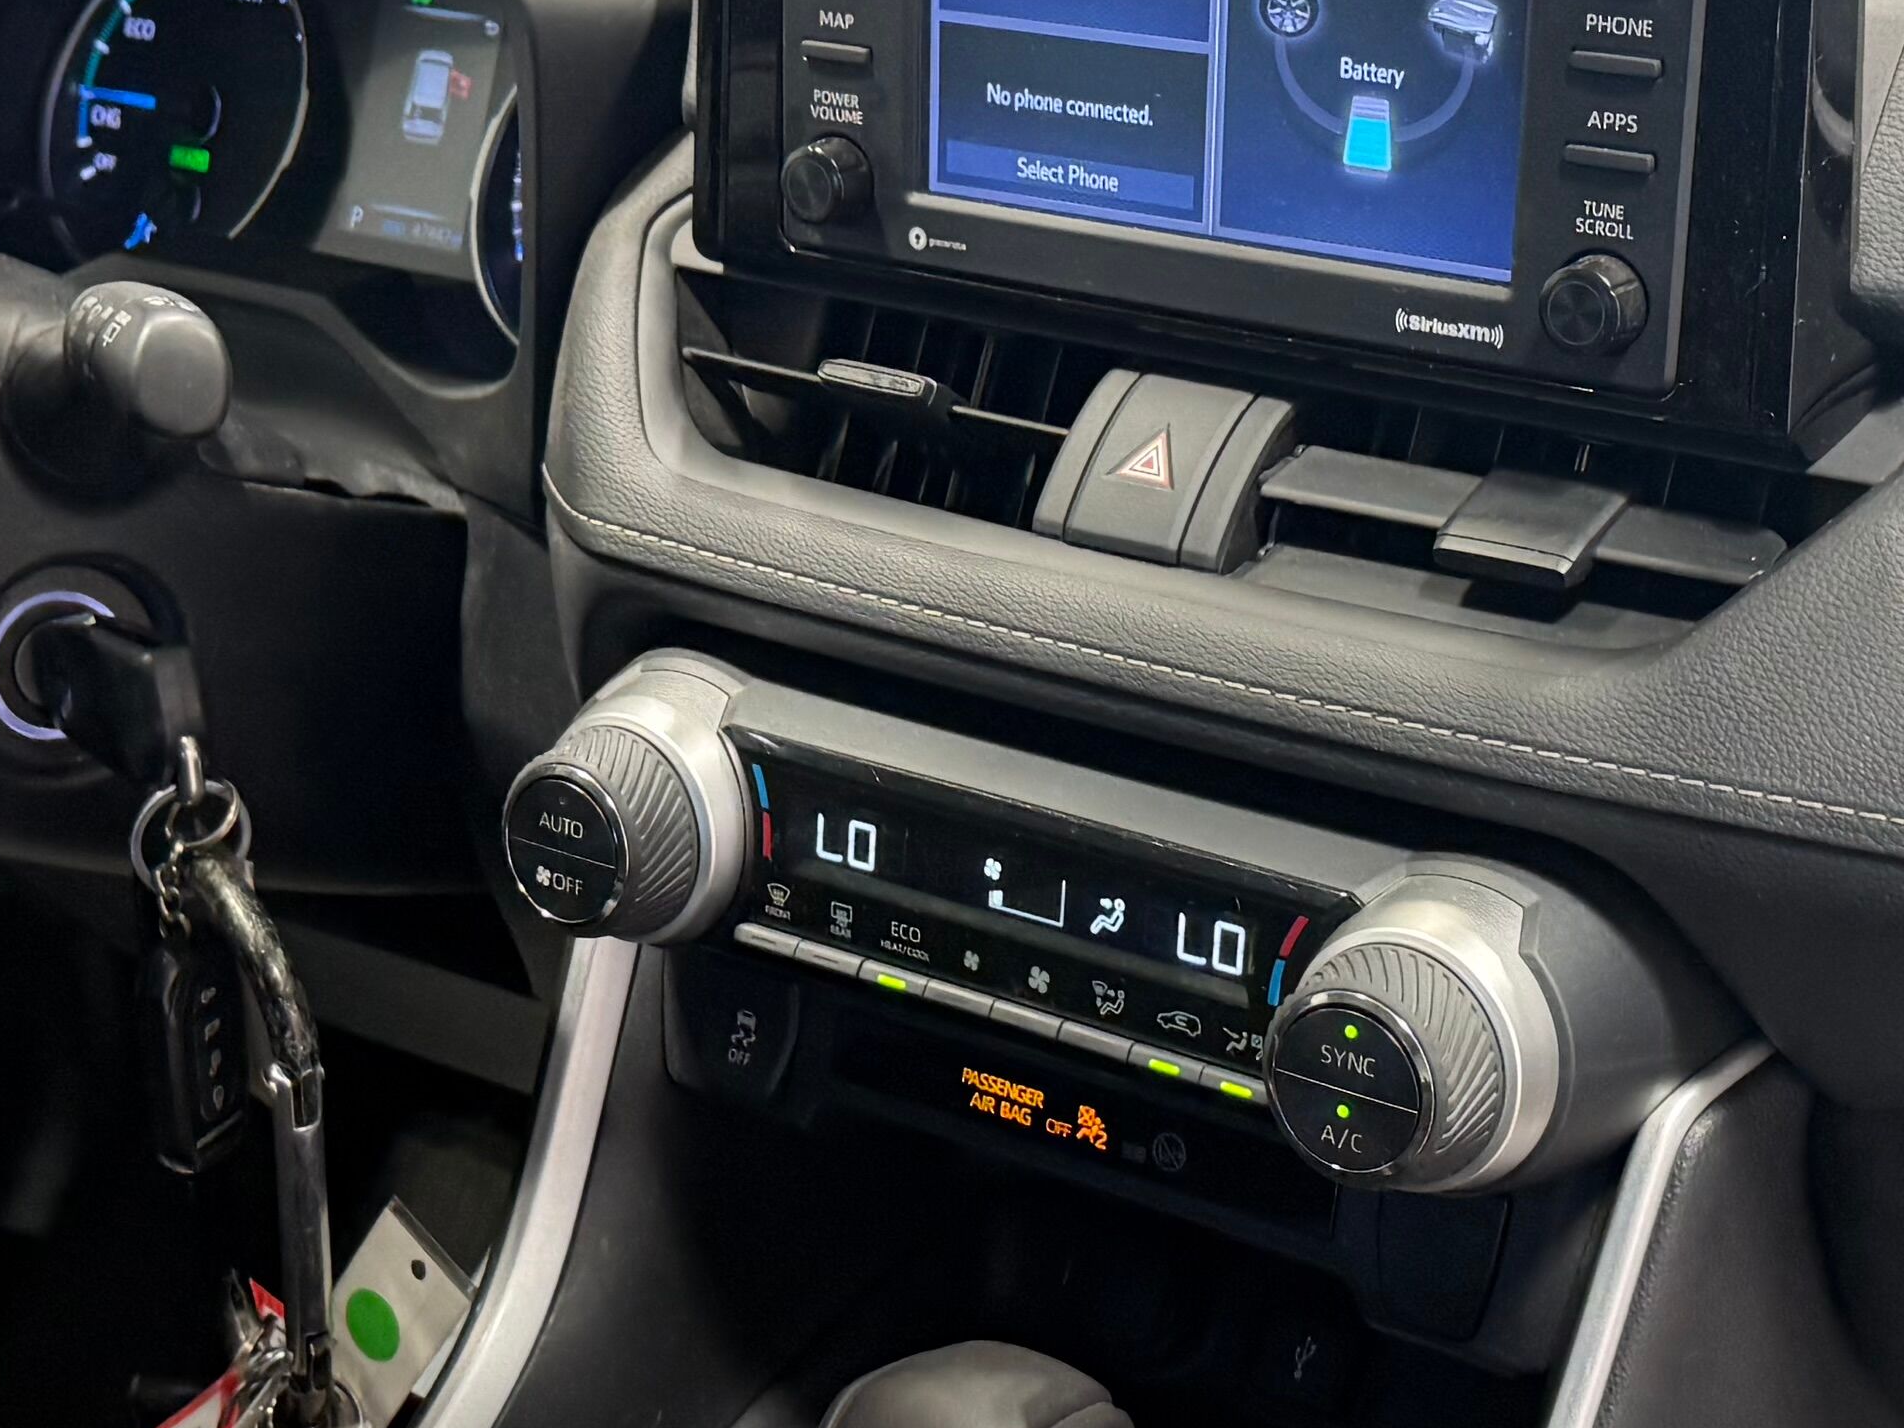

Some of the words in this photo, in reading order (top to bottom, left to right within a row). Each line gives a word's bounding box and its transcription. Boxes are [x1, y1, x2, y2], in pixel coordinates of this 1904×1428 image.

[818, 9, 855, 30] MAP
[1585, 13, 1653, 38] PHONE
[1339, 56, 1405, 90] Battery
[813, 88, 860, 109] POWER
[986, 81, 1012, 106] No
[1014, 87, 1063, 114] phone
[1066, 98, 1154, 126] connected.
[810, 103, 864, 126] VOLUME
[1586, 110, 1639, 134] APPS
[1016, 156, 1065, 185] Select
[1068, 164, 1120, 193] Phone
[1583, 199, 1625, 221] TUNE
[1575, 217, 1634, 241] SCROLL
[538, 811, 584, 839] AUTO
[815, 812, 877, 873] LO
[552, 872, 584, 896] OFF
[891, 920, 922, 943] ECO
[1176, 911, 1246, 977] LO
[1320, 1044, 1376, 1078] SYNC
[961, 1067, 1045, 1109] PASSENGER
[969, 1091, 996, 1115] AIR
[1000, 1100, 1032, 1127] BAG
[1046, 1118, 1073, 1138] OFF
[1320, 1124, 1363, 1154] A/C
